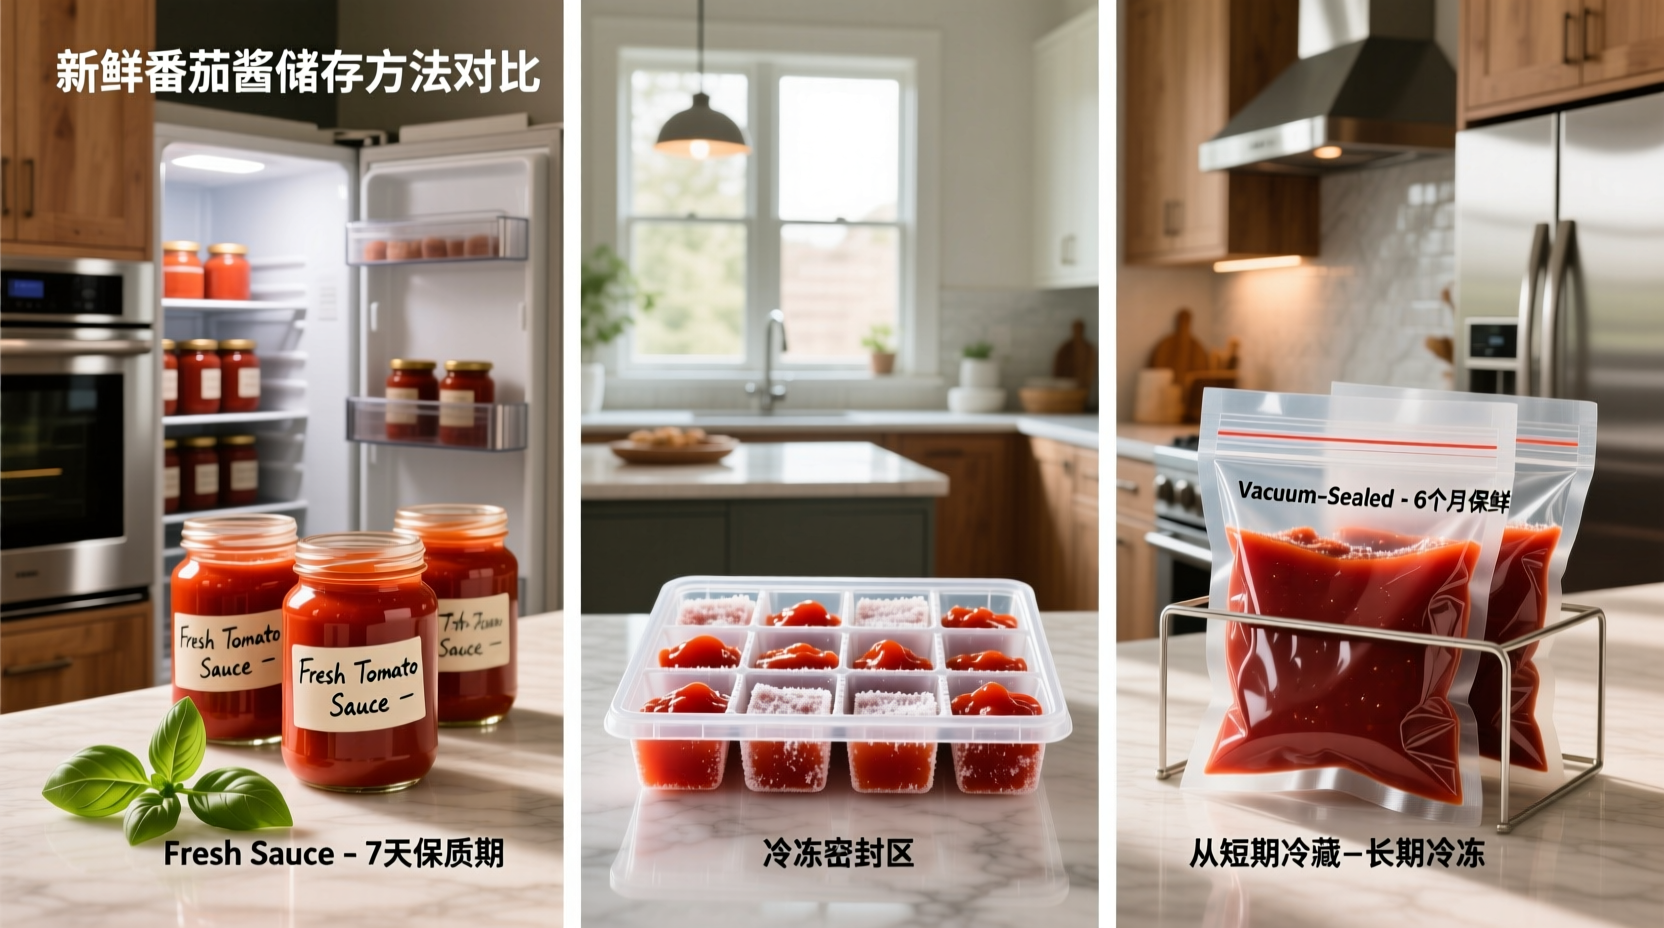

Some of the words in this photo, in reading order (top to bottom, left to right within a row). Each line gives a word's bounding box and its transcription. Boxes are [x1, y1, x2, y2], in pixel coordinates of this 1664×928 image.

[1413, 487, 1511, 515] 6个月保鲜
[179, 625, 215, 650] Fresh
[222, 624, 281, 650] Tomato
[438, 638, 484, 658] Sauce
[200, 657, 253, 679] Sauce
[298, 657, 346, 685] Fresh
[353, 656, 418, 684] Tomato
[329, 692, 390, 717] Sauce
